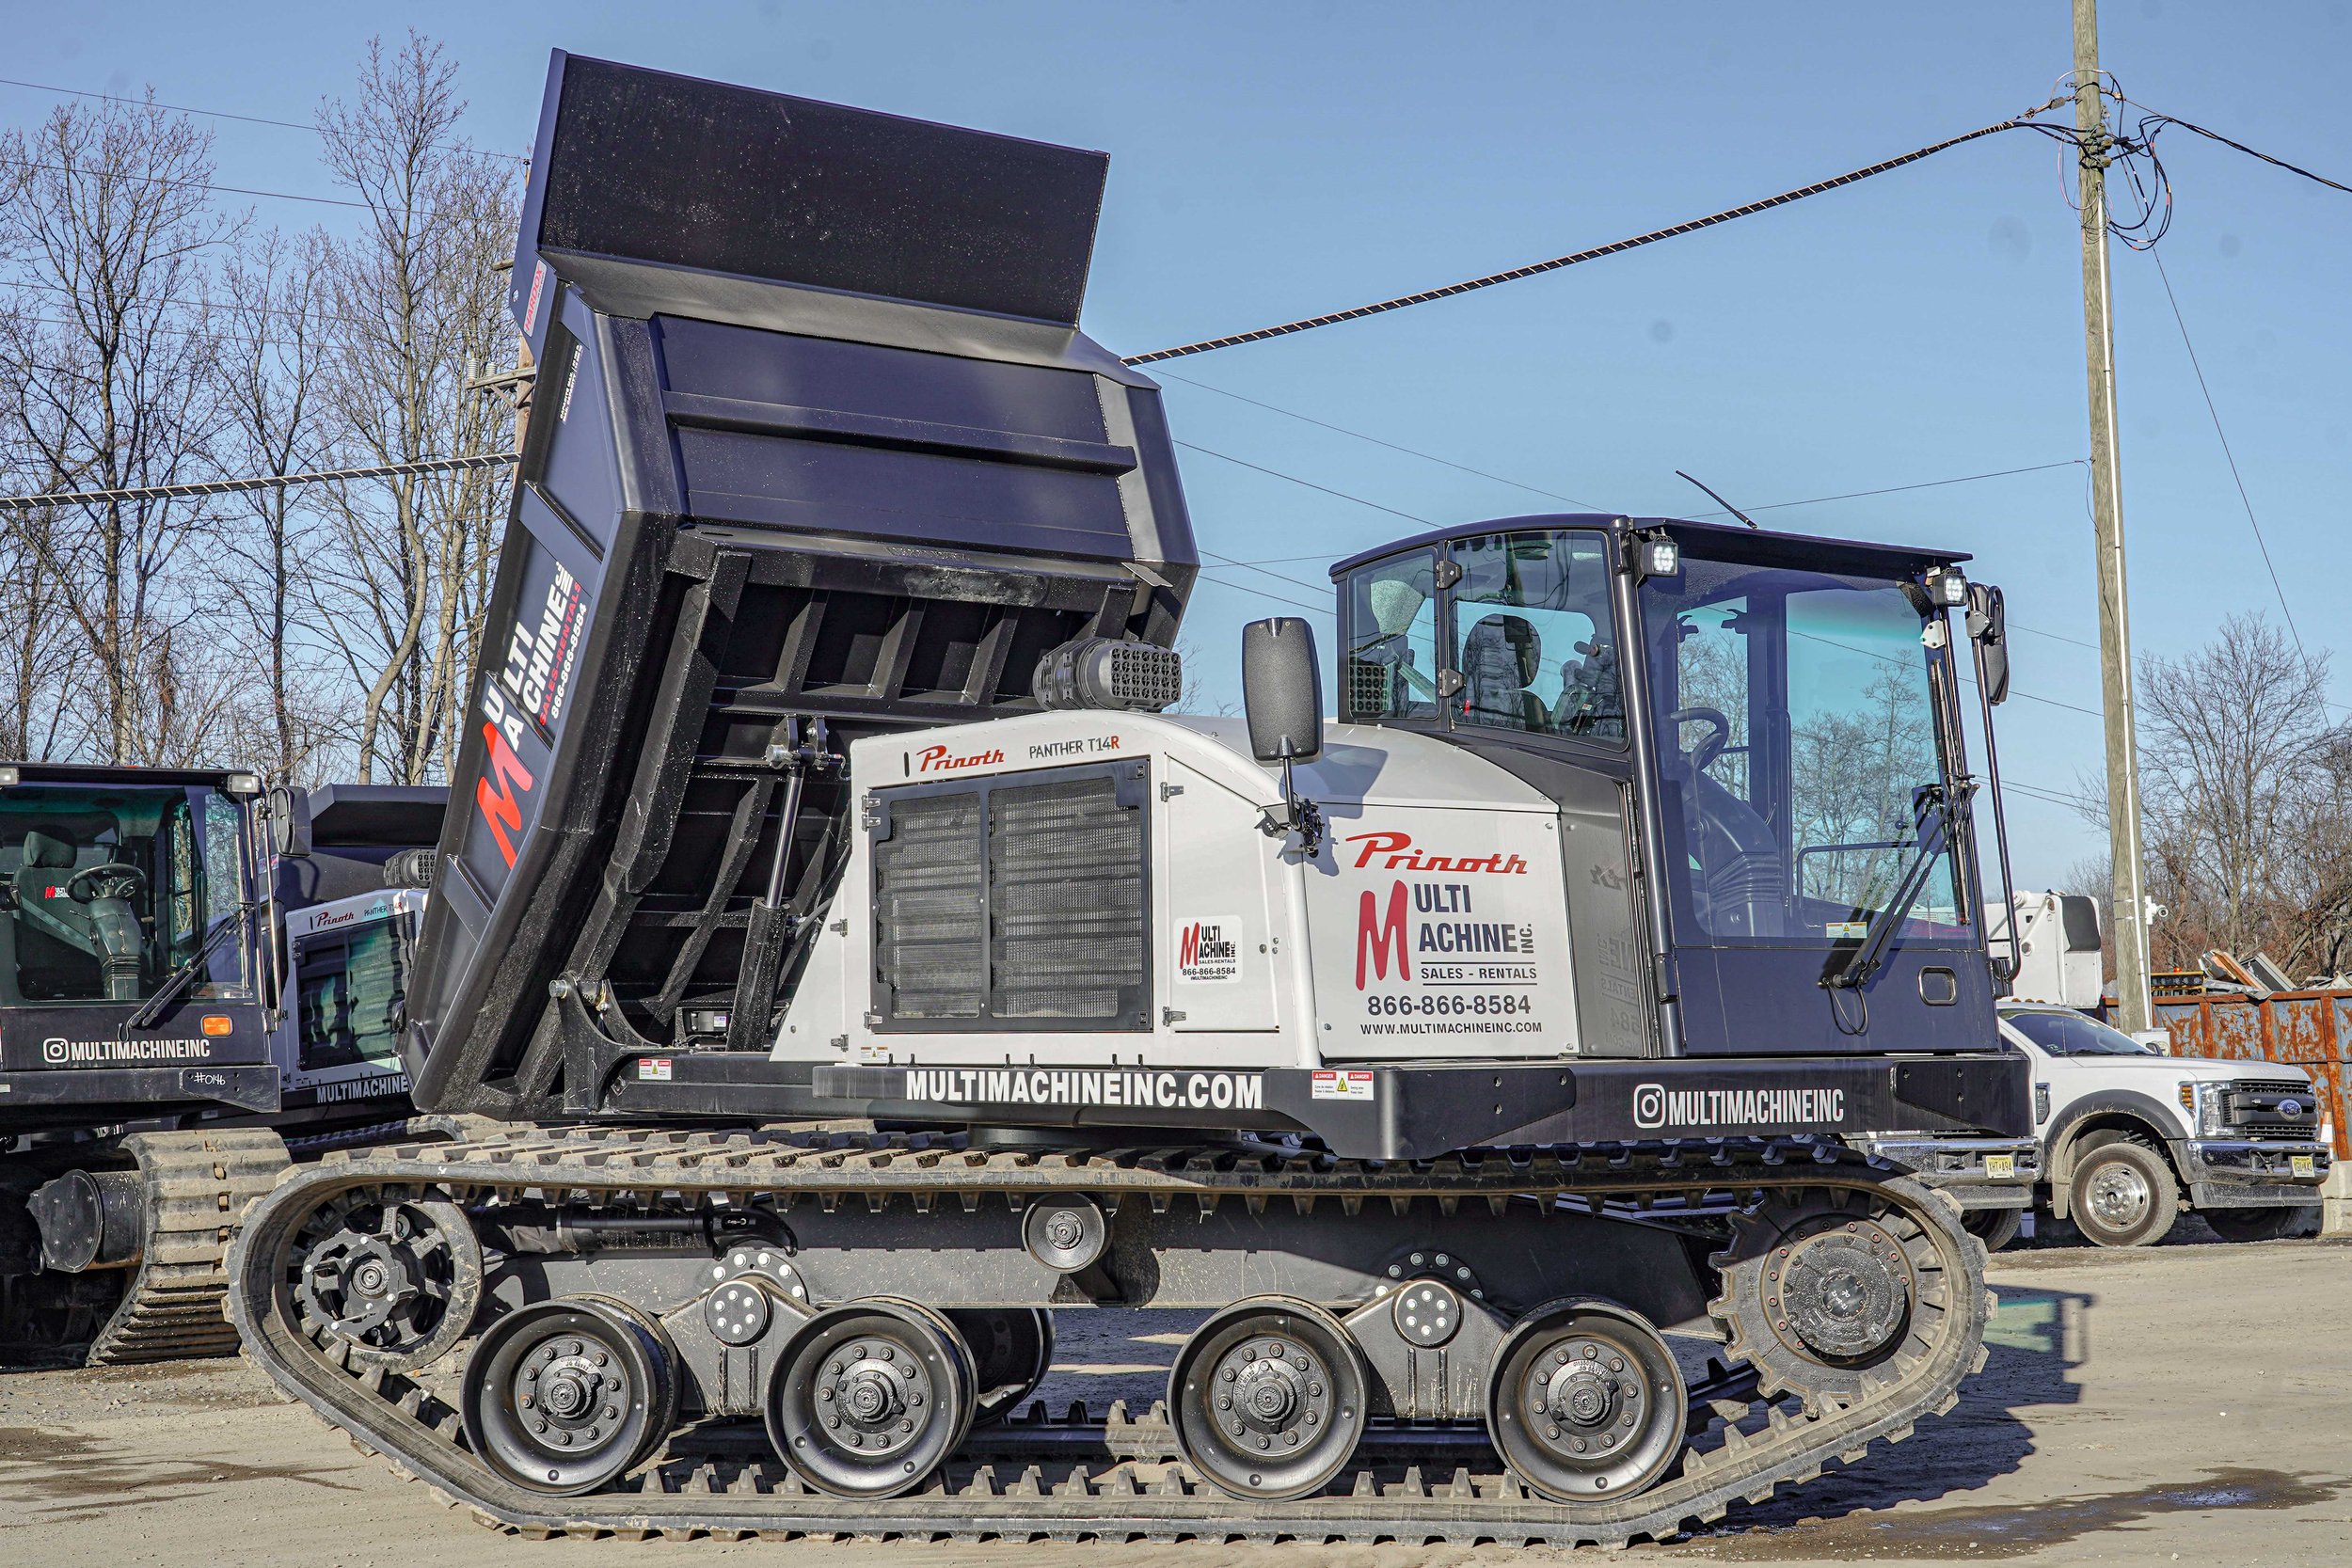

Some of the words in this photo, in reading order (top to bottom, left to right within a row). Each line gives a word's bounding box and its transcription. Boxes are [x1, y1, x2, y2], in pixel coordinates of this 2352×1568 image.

[524, 264, 543, 332] HARDOX
[551, 602, 587, 719] 866-866-8584
[915, 745, 1005, 772] Prinoth
[1029, 739, 1083, 759] PANTHER
[1088, 736, 1120, 752] T14R
[1345, 832, 1528, 874] Prinoth
[315, 911, 354, 927] Prinoth
[364, 906, 387, 916] PANTHER
[1519, 923, 1534, 954] INC.
[1183, 967, 1235, 975] 866-866-8584
[1422, 968, 1463, 979] SALES
[1479, 968, 1537, 979] RENTALS
[1368, 995, 1532, 1015] 866-866-8584
[1360, 1022, 1542, 1035] WWW.MULTIMACHINEINC.COM
[71, 1038, 211, 1061] MULTIMACHINEINC
[906, 1069, 1263, 1109] MULTIMACHINEINC.COM
[1668, 1088, 1844, 1125] MULTIMACHINEINC
